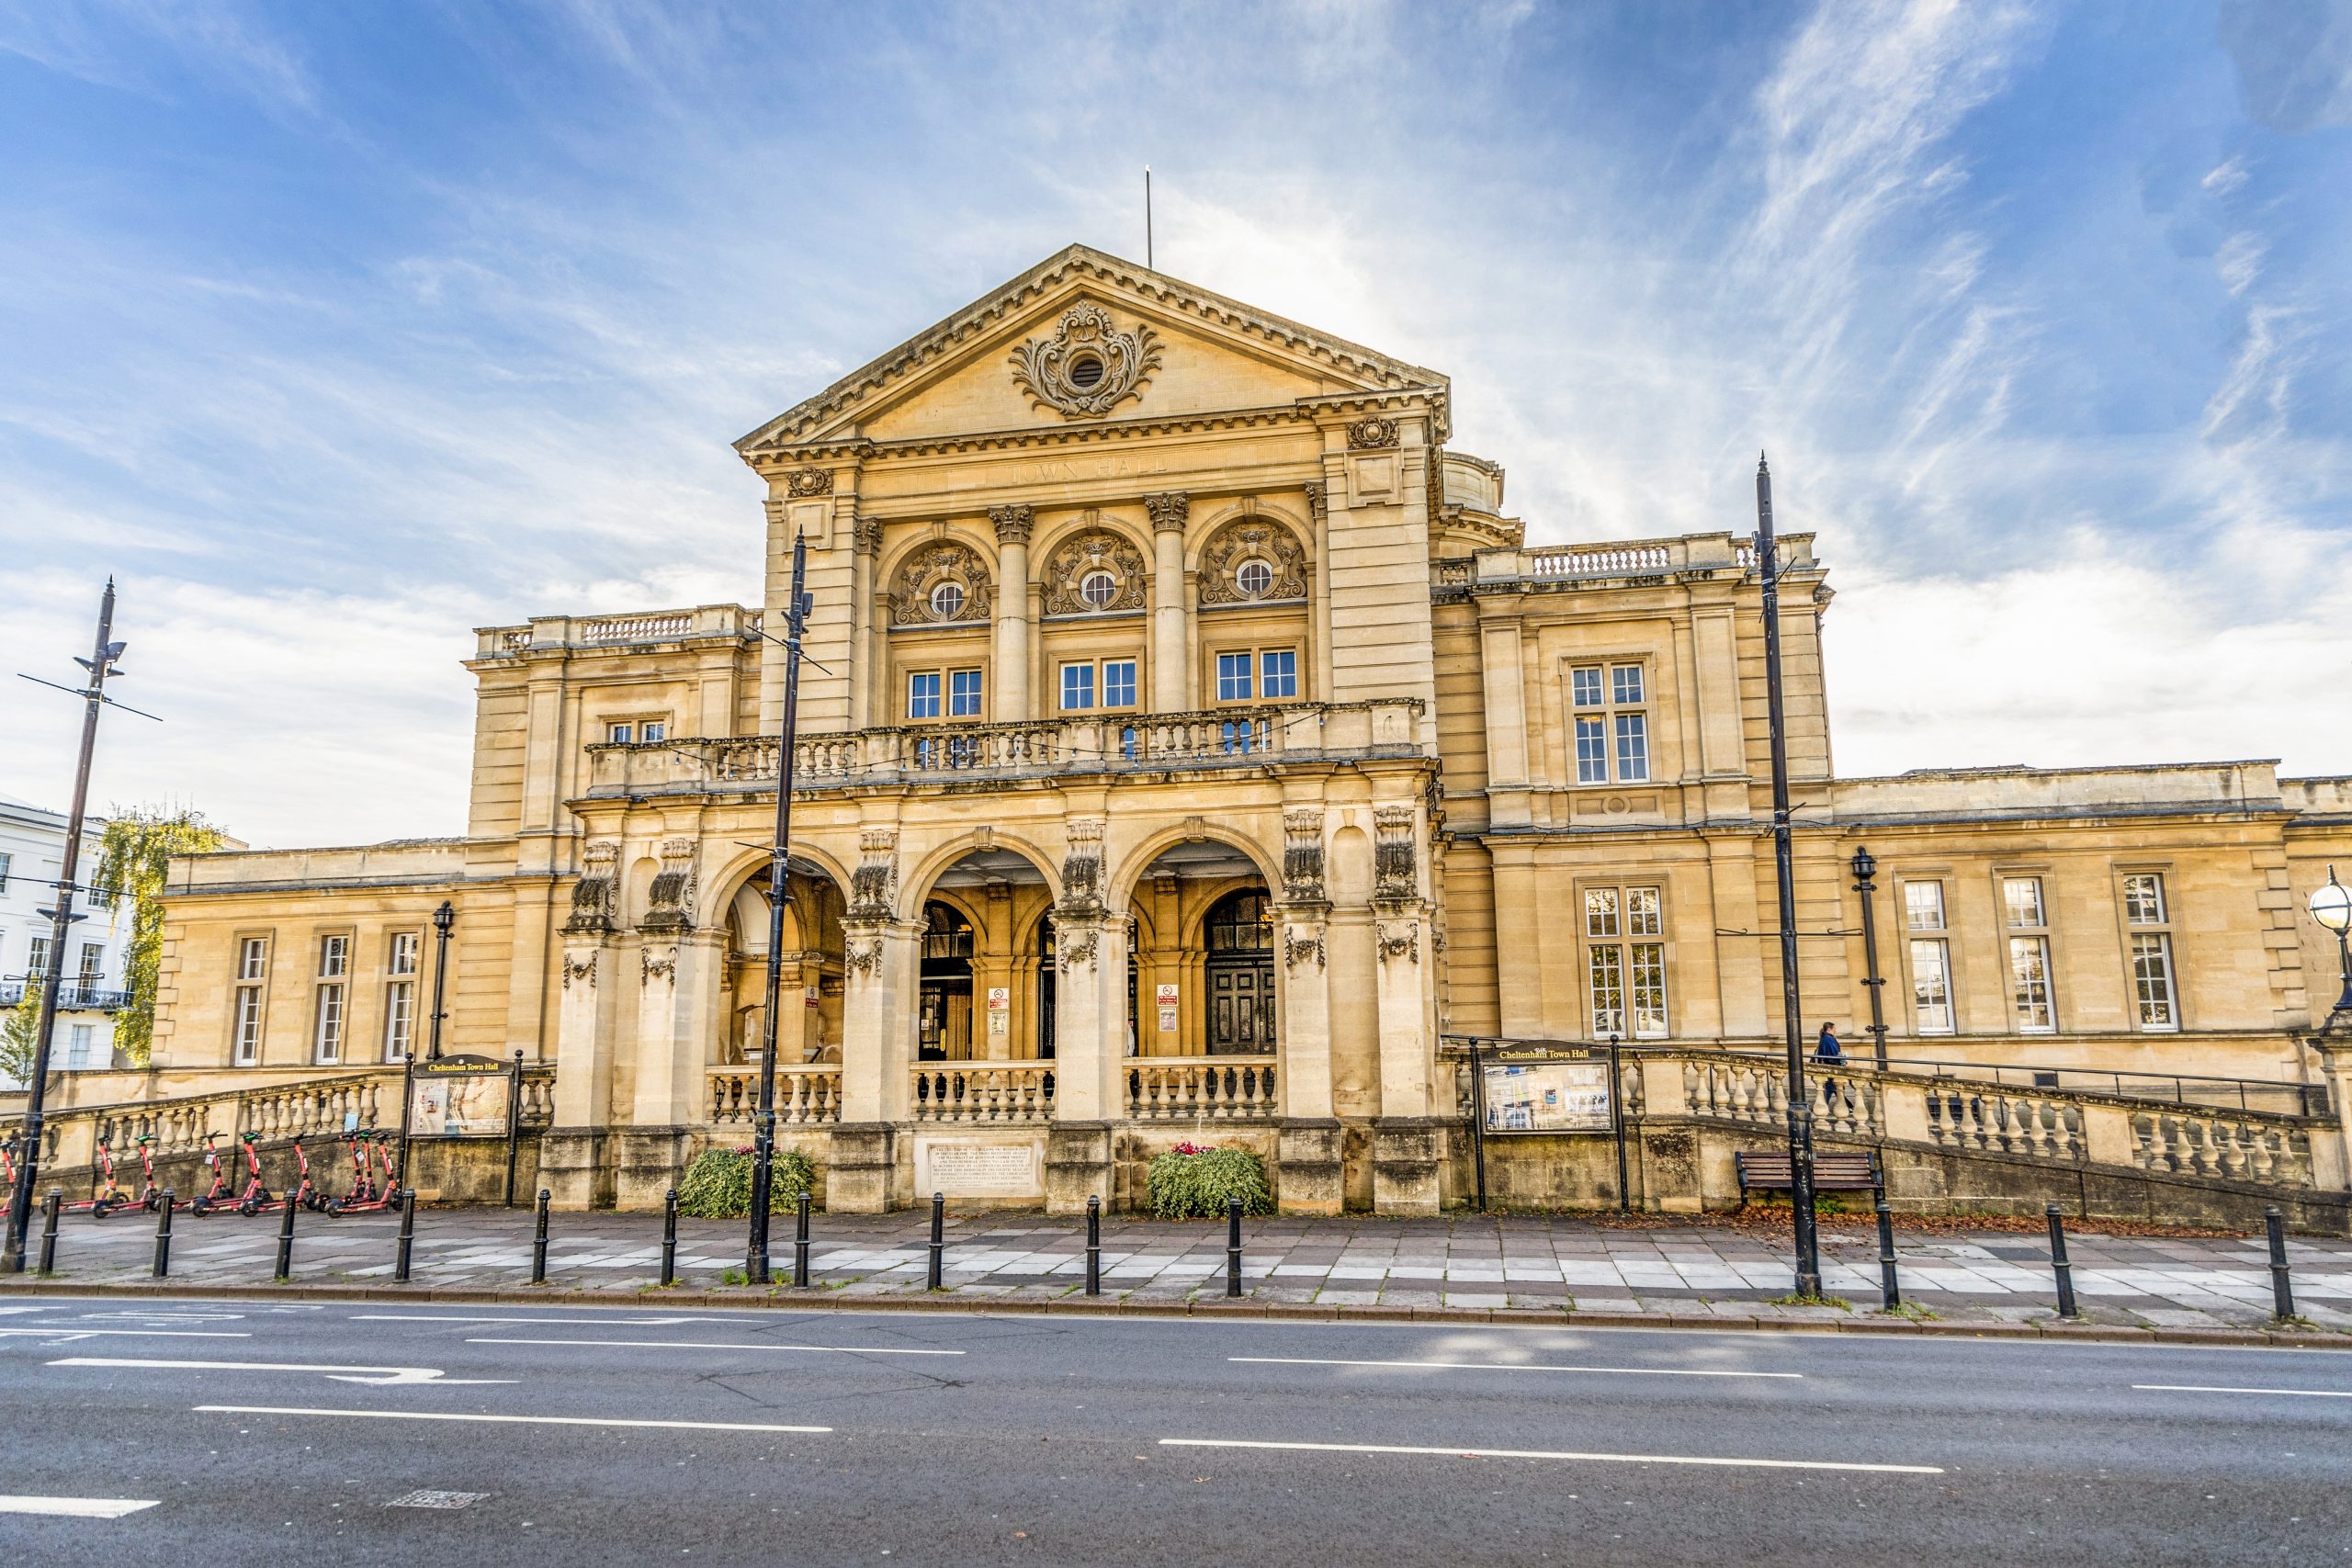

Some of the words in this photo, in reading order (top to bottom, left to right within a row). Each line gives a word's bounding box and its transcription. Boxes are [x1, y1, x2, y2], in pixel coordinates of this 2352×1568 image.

[1012, 461, 1078, 484] TOWN
[1095, 454, 1168, 477] HALL
[1499, 1051, 1547, 1059] Cheltenham
[1572, 1049, 1589, 1057] Hall
[428, 1064, 466, 1072] Cheltenham
